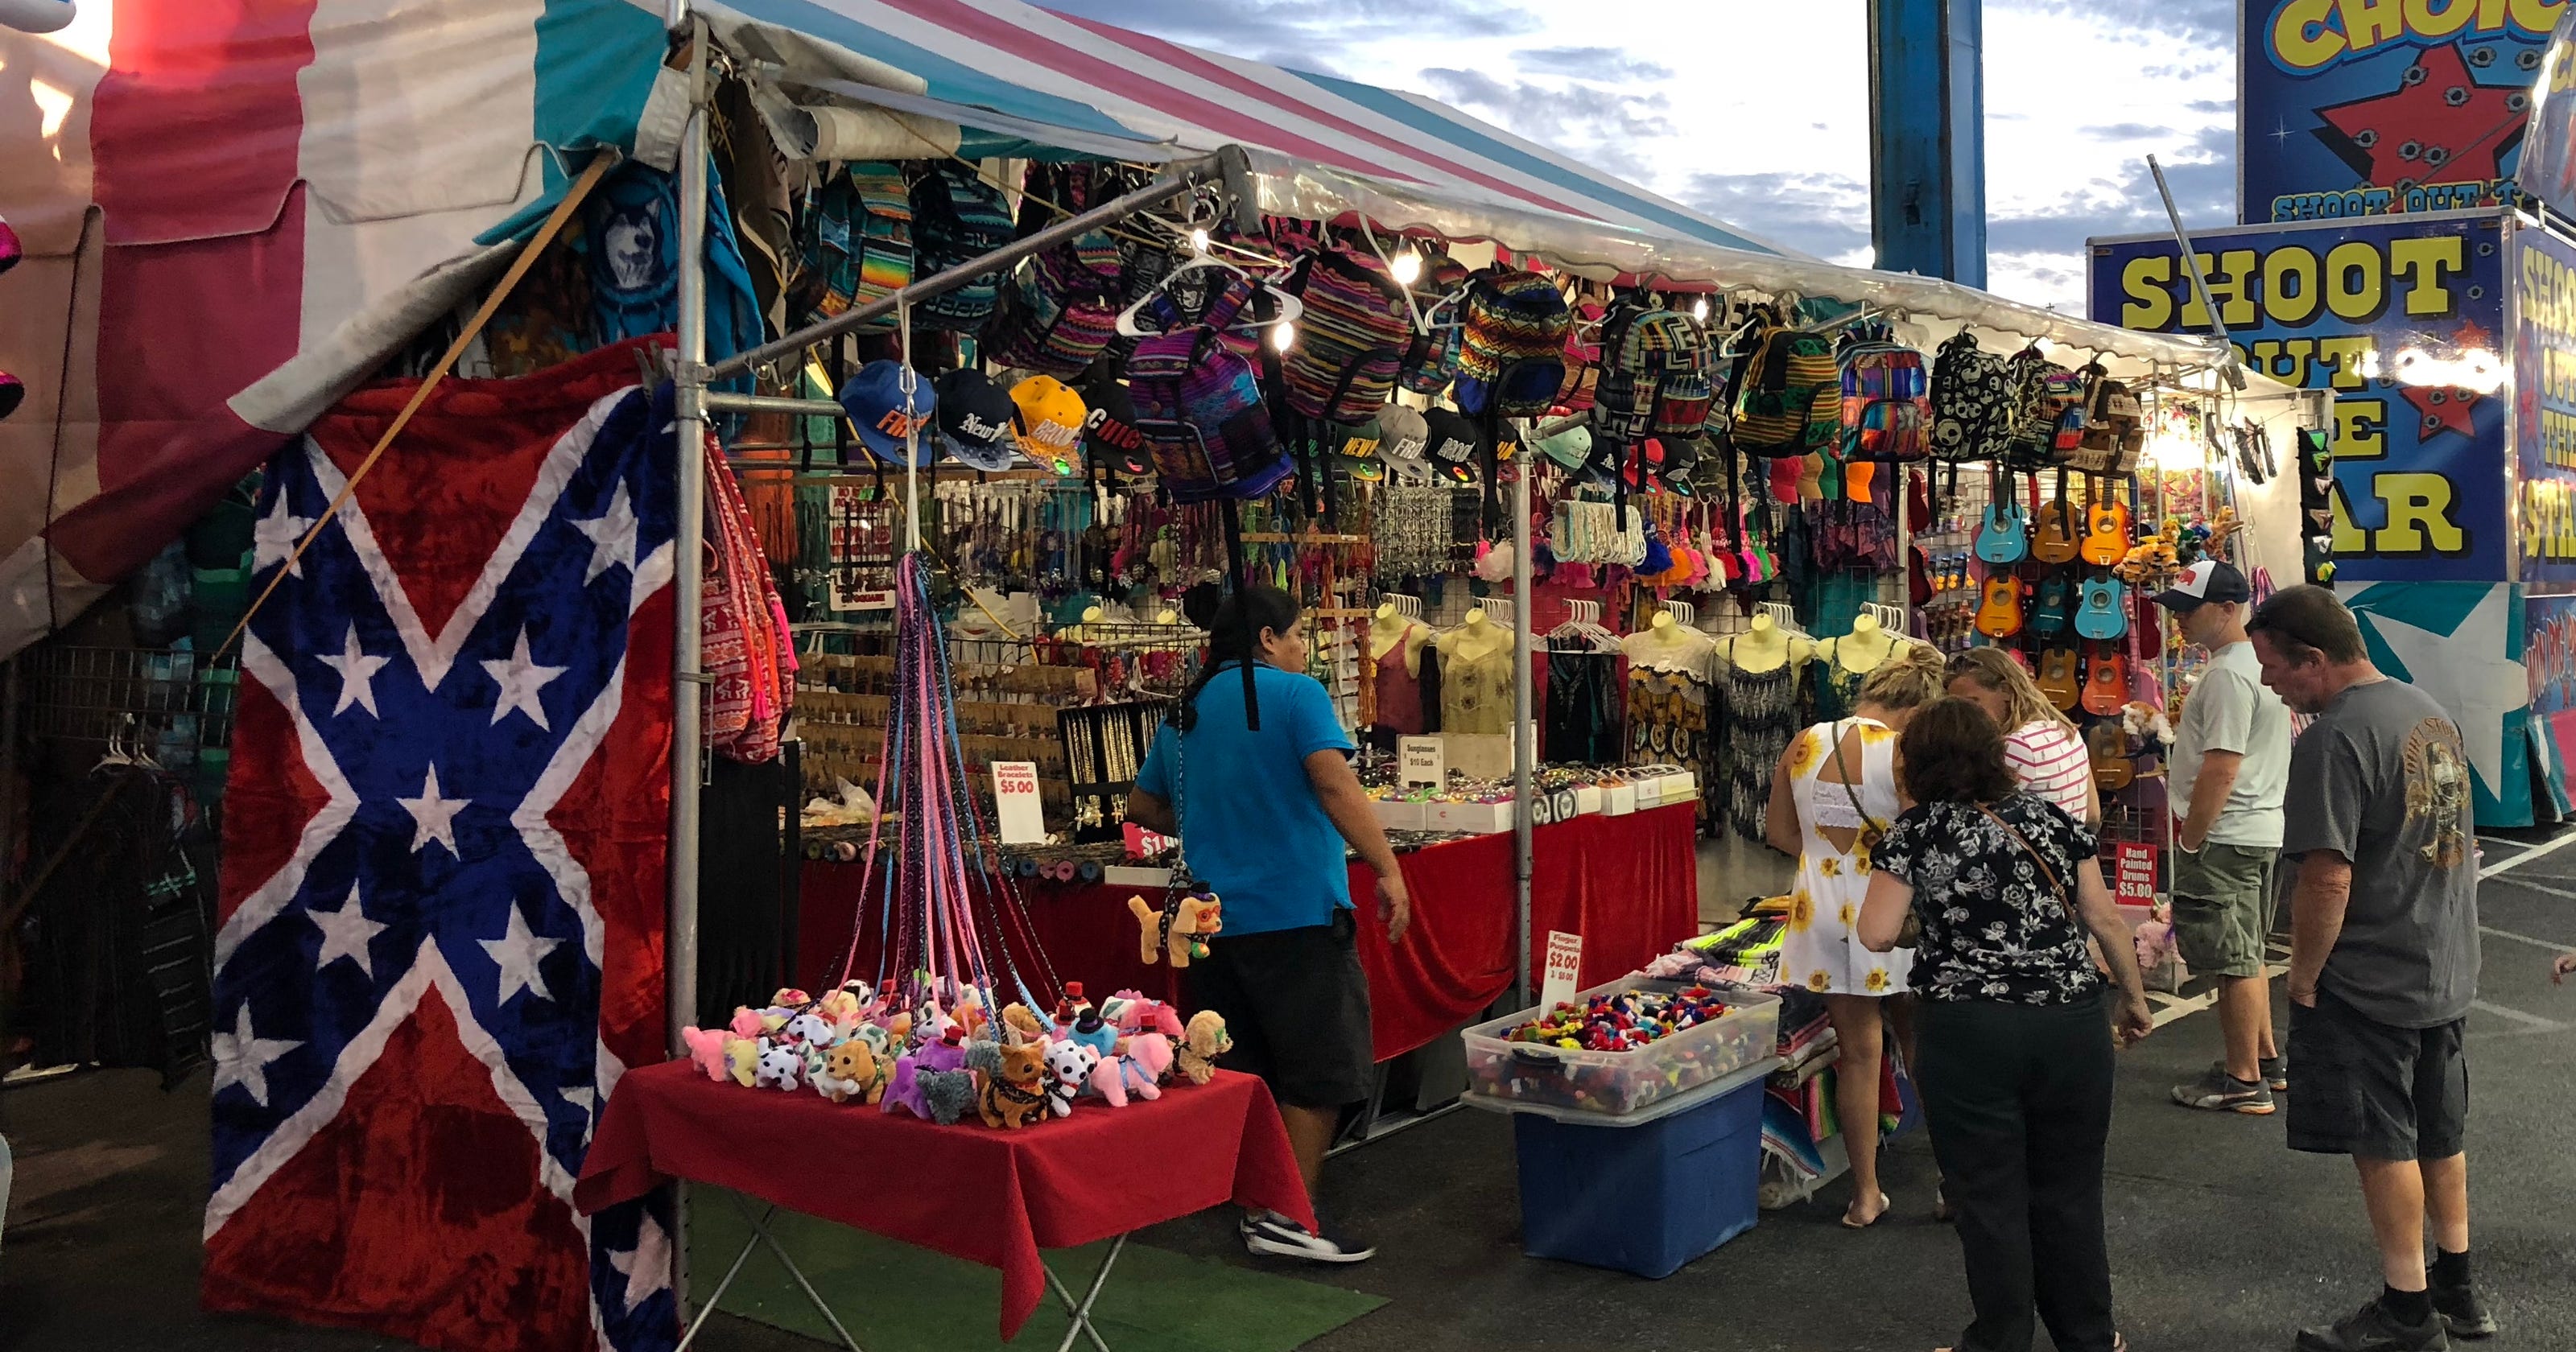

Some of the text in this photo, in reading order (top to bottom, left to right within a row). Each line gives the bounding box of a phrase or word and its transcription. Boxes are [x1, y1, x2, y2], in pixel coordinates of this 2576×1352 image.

[2273, 188, 2393, 222] SHOOT
[2405, 182, 2482, 212] OUT
[2122, 237, 2462, 329] SHOOT
[2231, 337, 2376, 390] UT
[1407, 744, 1436, 754] Sunglasses
[1421, 758, 1434, 766] Each
[2126, 847, 2148, 859] Hand
[2120, 858, 2153, 871] Painted
[2123, 870, 2150, 882] Drums
[2120, 881, 2153, 898] $5.00
[1554, 934, 1578, 944] Finger
[1550, 942, 1580, 953] Puppets
